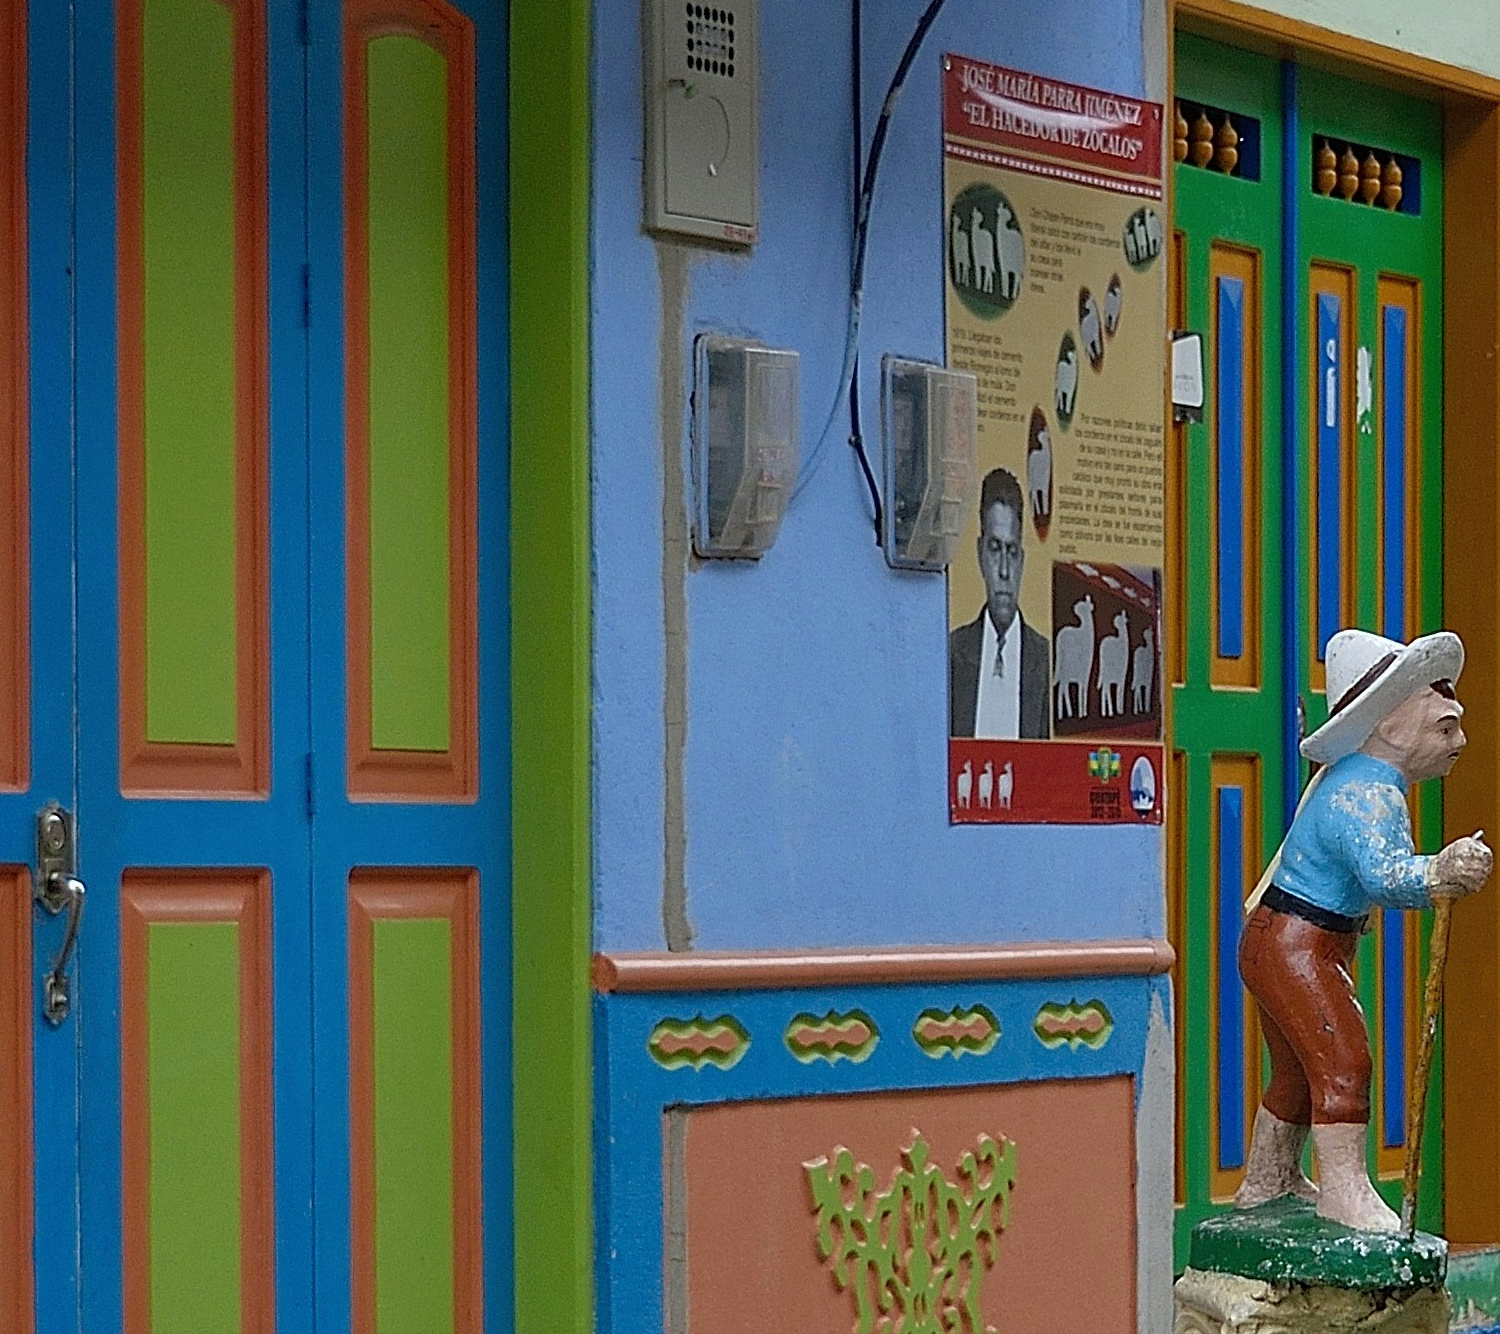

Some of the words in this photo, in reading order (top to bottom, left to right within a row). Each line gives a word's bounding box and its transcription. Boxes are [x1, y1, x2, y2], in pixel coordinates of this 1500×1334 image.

[962, 65, 994, 92] JOSÉ
[1000, 71, 1039, 104] MARÍA
[1043, 84, 1082, 114] PARRA
[1085, 94, 1142, 126] JIMÉNEZ
[993, 107, 1059, 142] HACEDOR
[1062, 126, 1080, 146] DE
